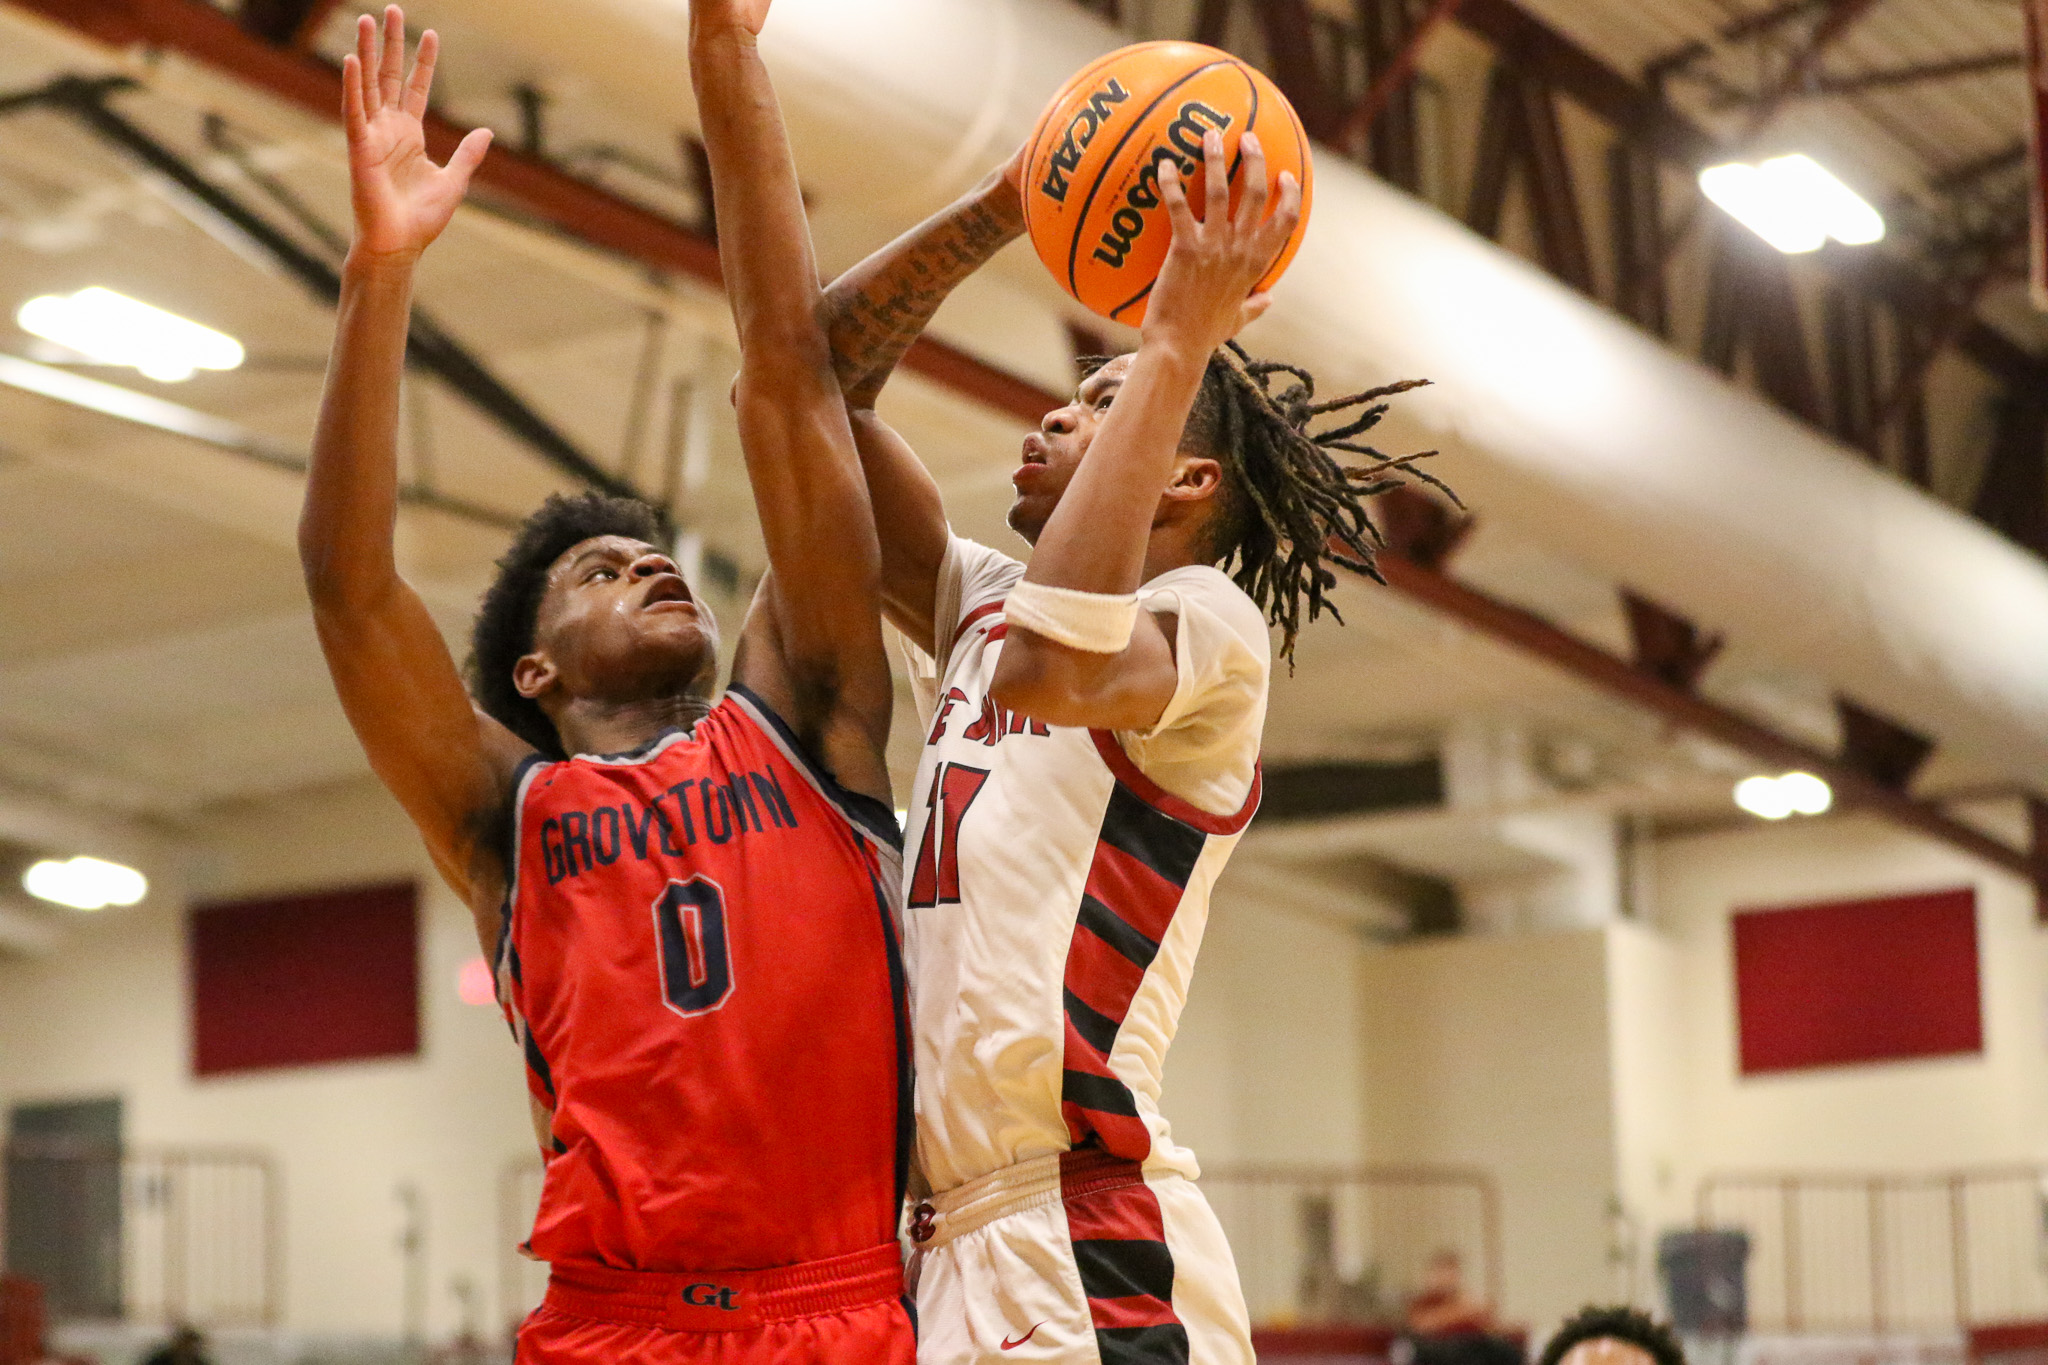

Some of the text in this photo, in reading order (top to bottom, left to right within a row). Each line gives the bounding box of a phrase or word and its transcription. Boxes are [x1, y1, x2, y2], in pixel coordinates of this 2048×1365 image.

[1041, 77, 1132, 203] NCAA
[540, 764, 799, 886] GROVETOWN
[651, 872, 736, 1019] 0
[681, 1283, 741, 1311] Gt
